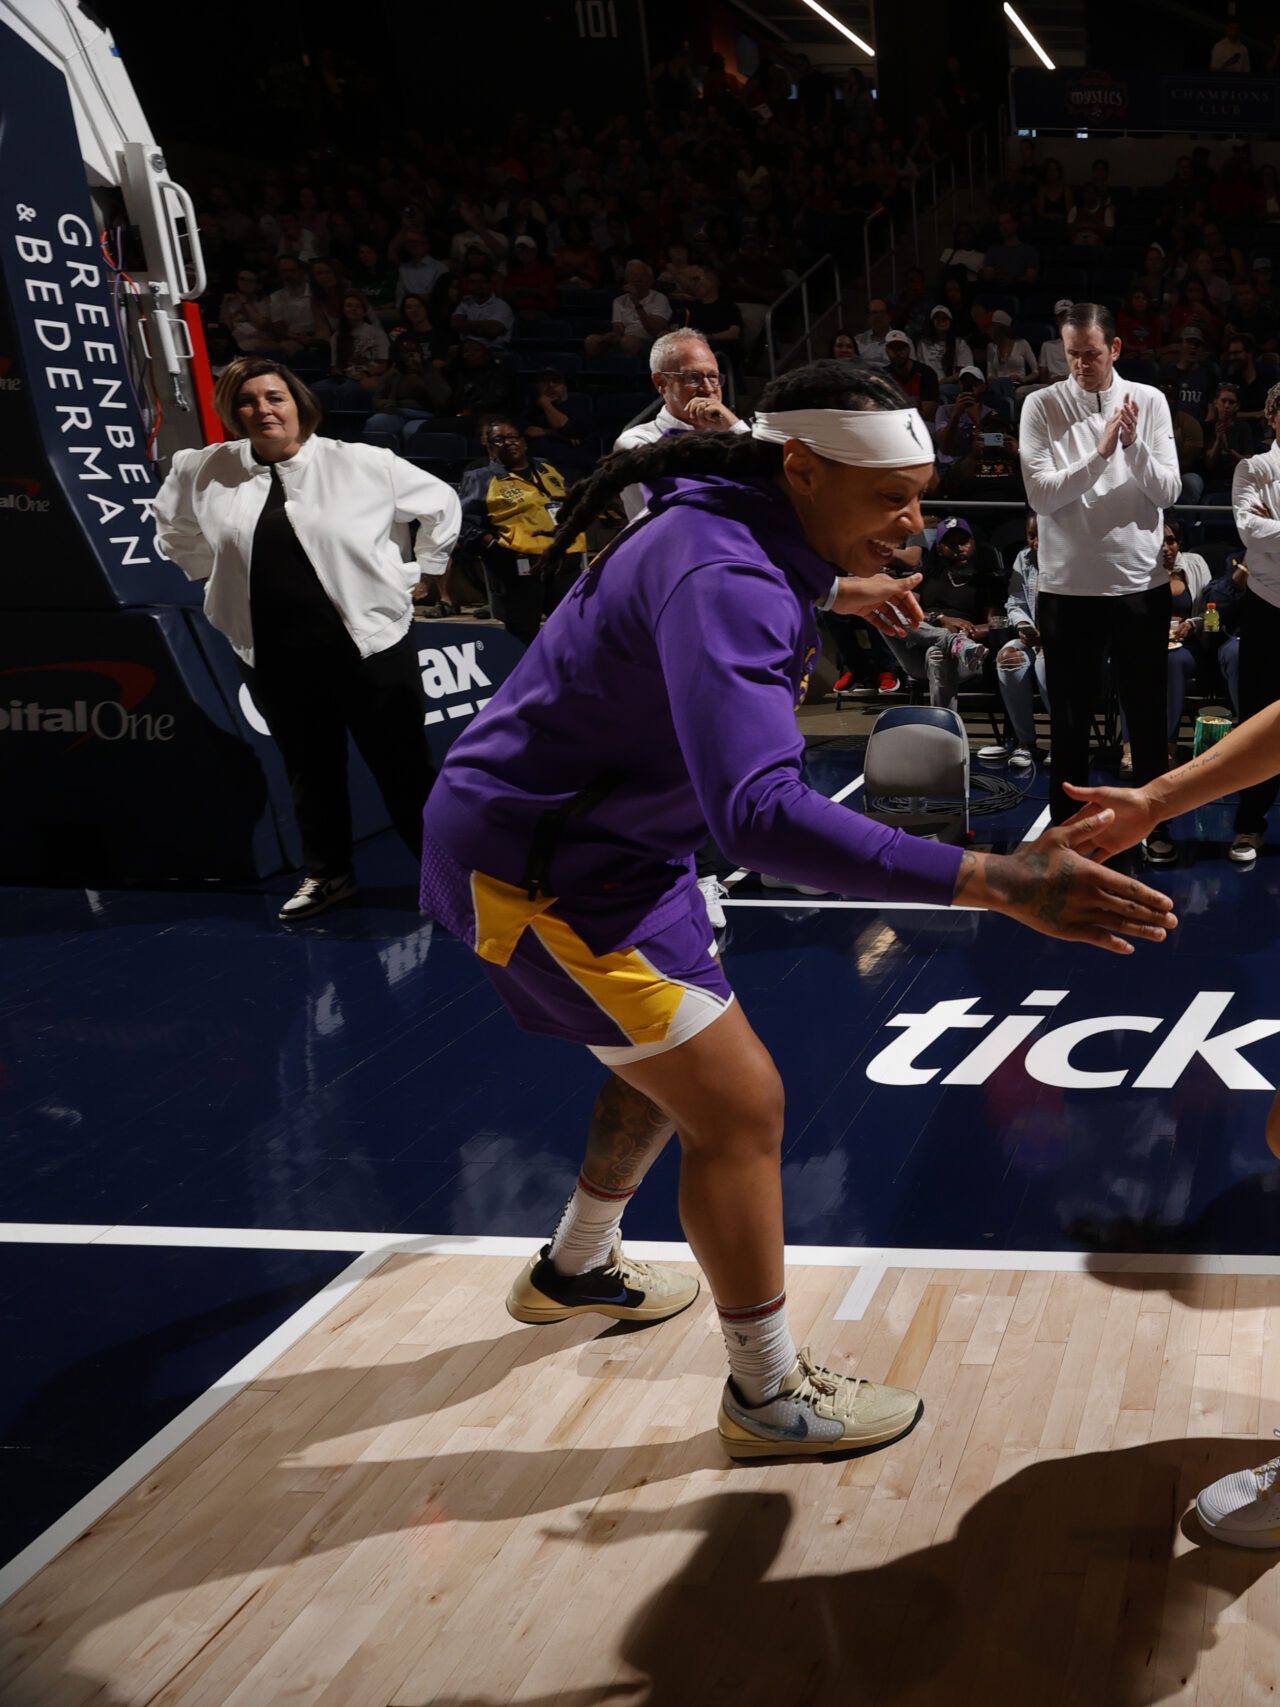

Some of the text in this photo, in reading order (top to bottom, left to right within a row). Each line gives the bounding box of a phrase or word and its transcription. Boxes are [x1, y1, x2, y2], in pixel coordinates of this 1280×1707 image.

[575, 0, 619, 38] 101
[1170, 88, 1272, 102] CHAMPIONS
[1200, 103, 1242, 116] CLUB
[15, 234, 152, 565] BEDERMAN
